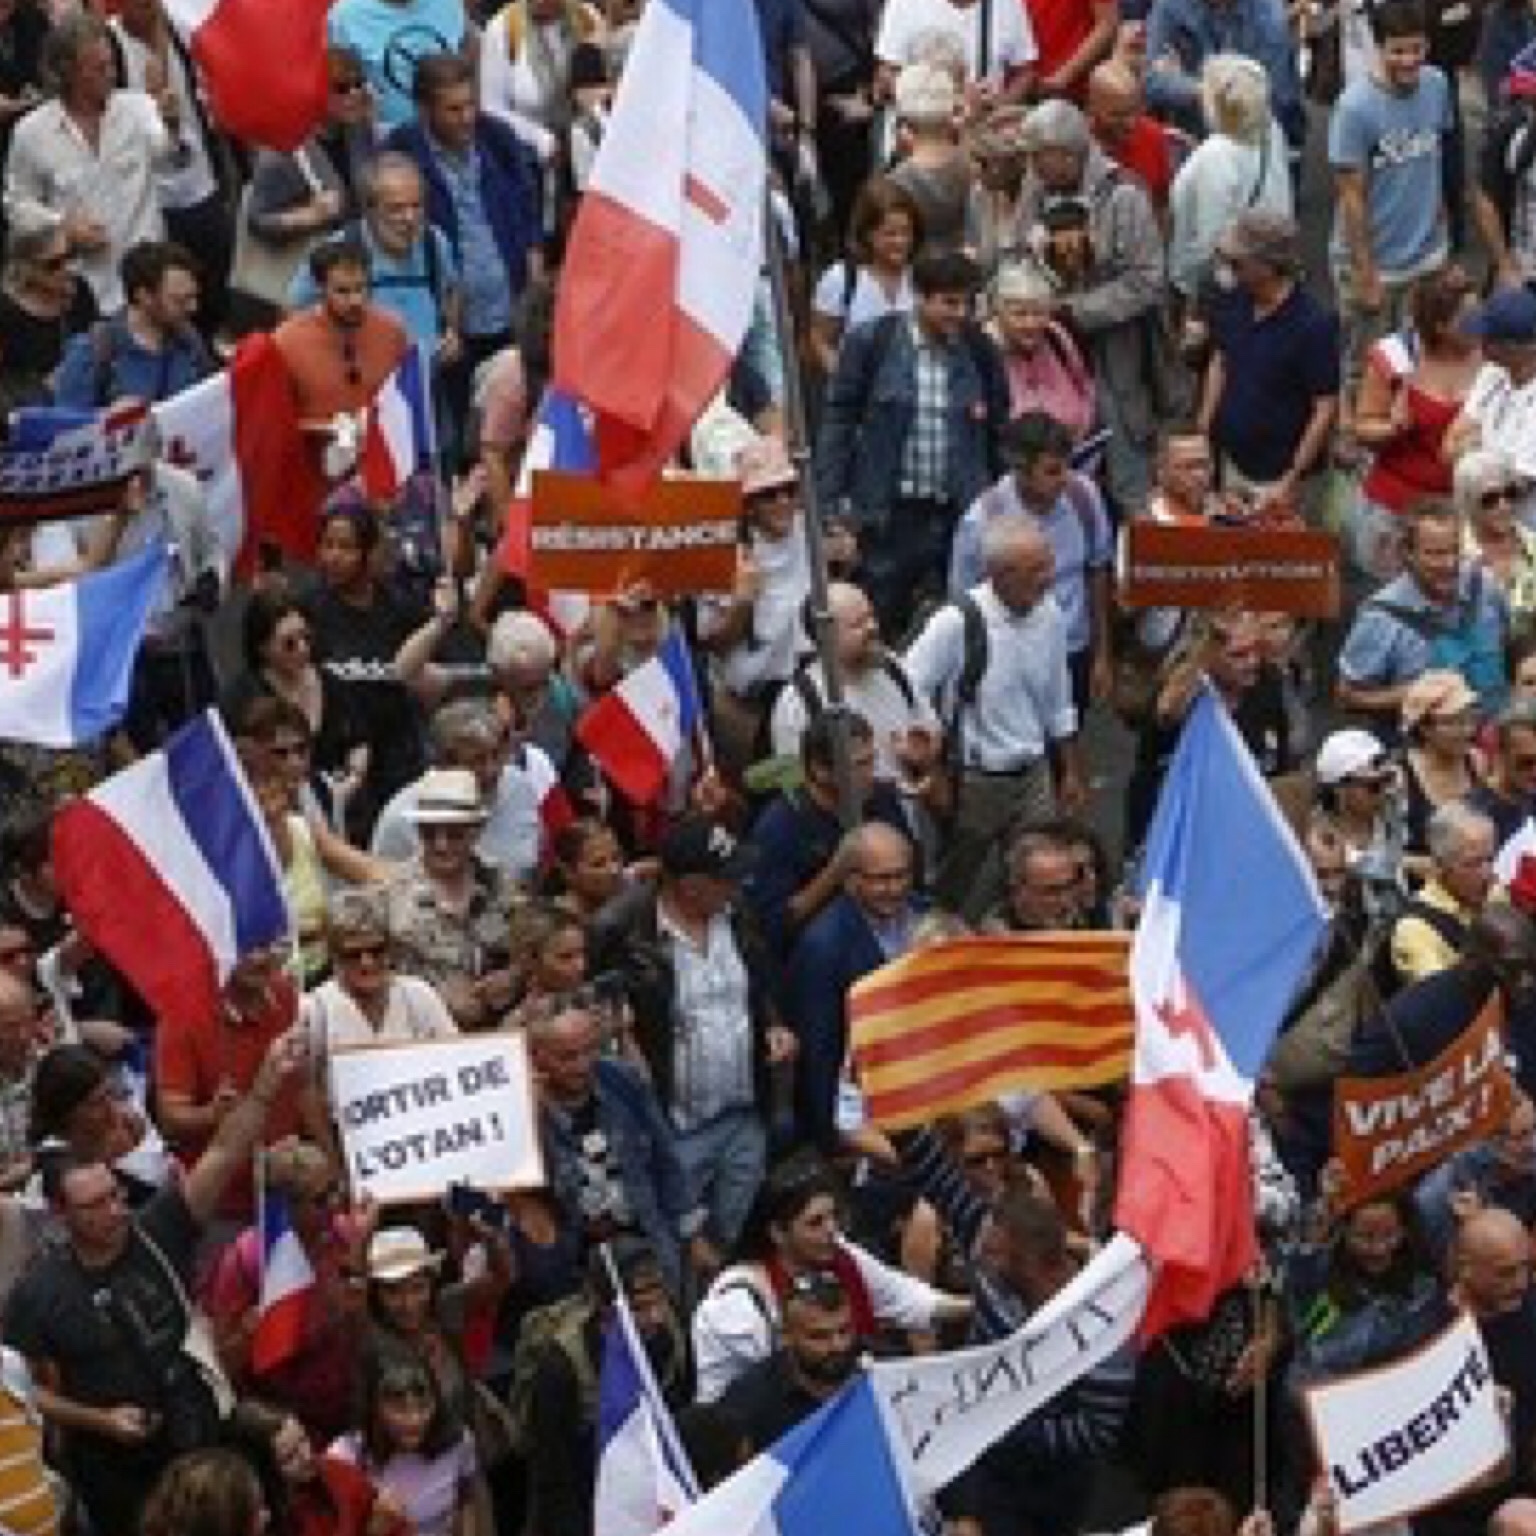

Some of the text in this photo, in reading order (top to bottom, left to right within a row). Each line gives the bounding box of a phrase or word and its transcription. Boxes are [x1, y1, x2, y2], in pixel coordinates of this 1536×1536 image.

[343, 1055, 511, 1129] ORTIR DE
[1343, 1066, 1456, 1136] VIVE
[354, 1117, 488, 1180] L'OTAN
